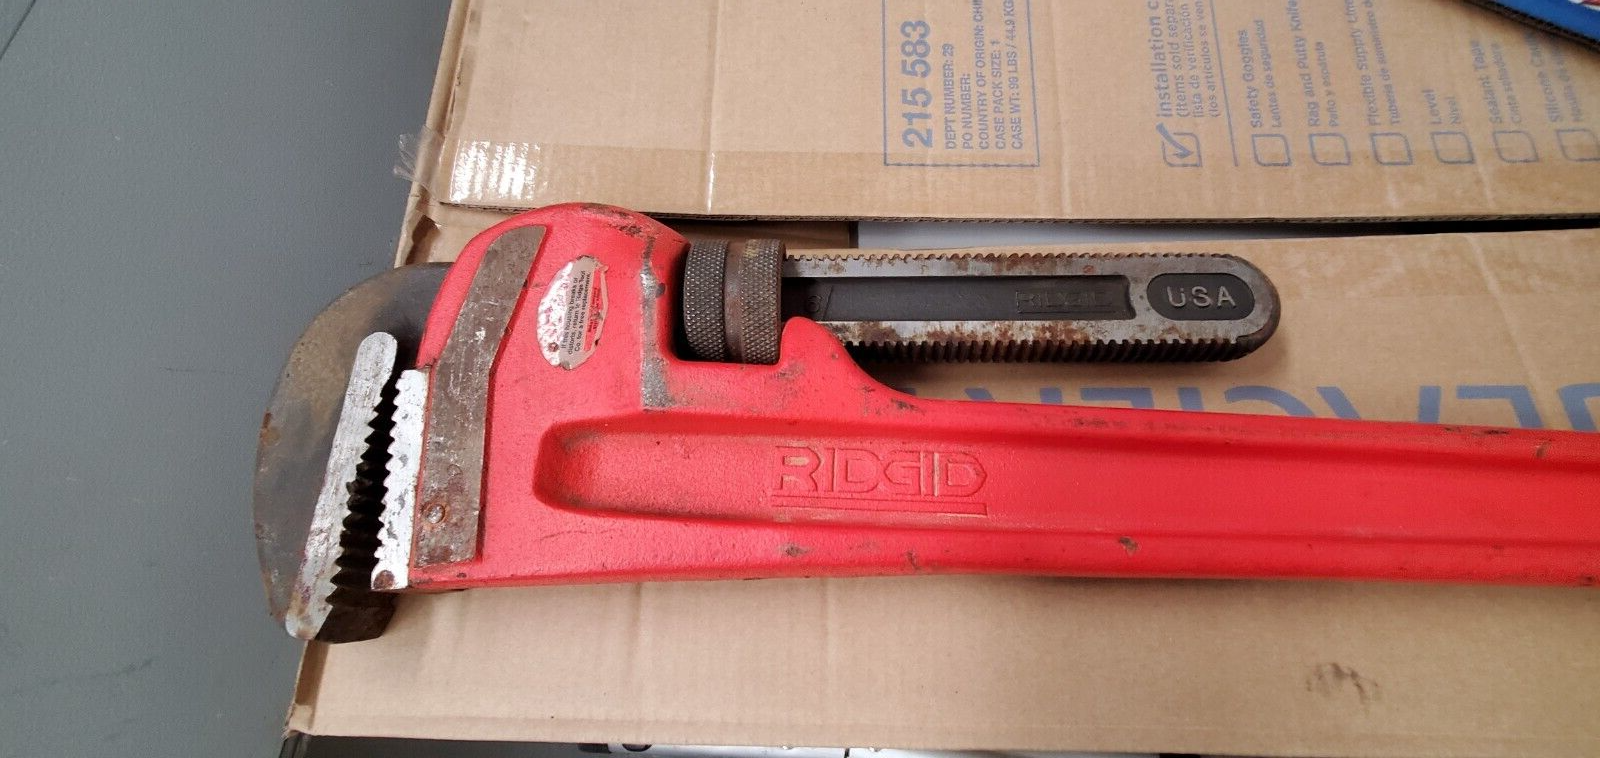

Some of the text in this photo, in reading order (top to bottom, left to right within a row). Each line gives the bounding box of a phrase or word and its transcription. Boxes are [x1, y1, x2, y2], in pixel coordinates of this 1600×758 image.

[973, 25, 986, 68] ORIGIN:
[1005, 19, 1016, 41] 44.9
[1199, 24, 1207, 37] se
[991, 50, 1002, 78] SIZE:
[1007, 52, 1018, 74] LBS
[1168, 42, 1182, 70] sold
[1181, 3, 1205, 117] lista de verificación
[1294, 36, 1309, 69] Putty
[1351, 28, 1368, 70] Supply
[900, 20, 933, 148] 215 583
[976, 72, 986, 87] OF
[1238, 29, 1262, 128] Safety Goggles
[1254, 20, 1281, 127] Lentes de seguridad
[1299, 73, 1315, 97] and
[1381, 68, 1391, 81] de
[942, 43, 956, 149] DEPT NUMBER: 29
[960, 73, 973, 149] PO NUMBER:
[992, 81, 1004, 114] PACK
[1009, 92, 1021, 114] WT:
[1175, 75, 1191, 117] (items
[1208, 95, 1221, 117] (los
[1360, 74, 1381, 125] Flexible
[1422, 89, 1442, 124] Level
[1445, 96, 1461, 124] Nivel
[1480, 75, 1502, 123] Sealant
[1537, 71, 1561, 122] Silicone
[977, 91, 989, 150] COUNTRY
[1307, 102, 1320, 127] Rag
[1327, 99, 1339, 127] Paño
[994, 117, 1005, 149] CASE
[1010, 117, 1024, 149] CASE
[564, 306, 574, 330] housing
[569, 285, 577, 305] breaks
[1165, 285, 1237, 309] USA
[771, 445, 988, 498] RIDGID
